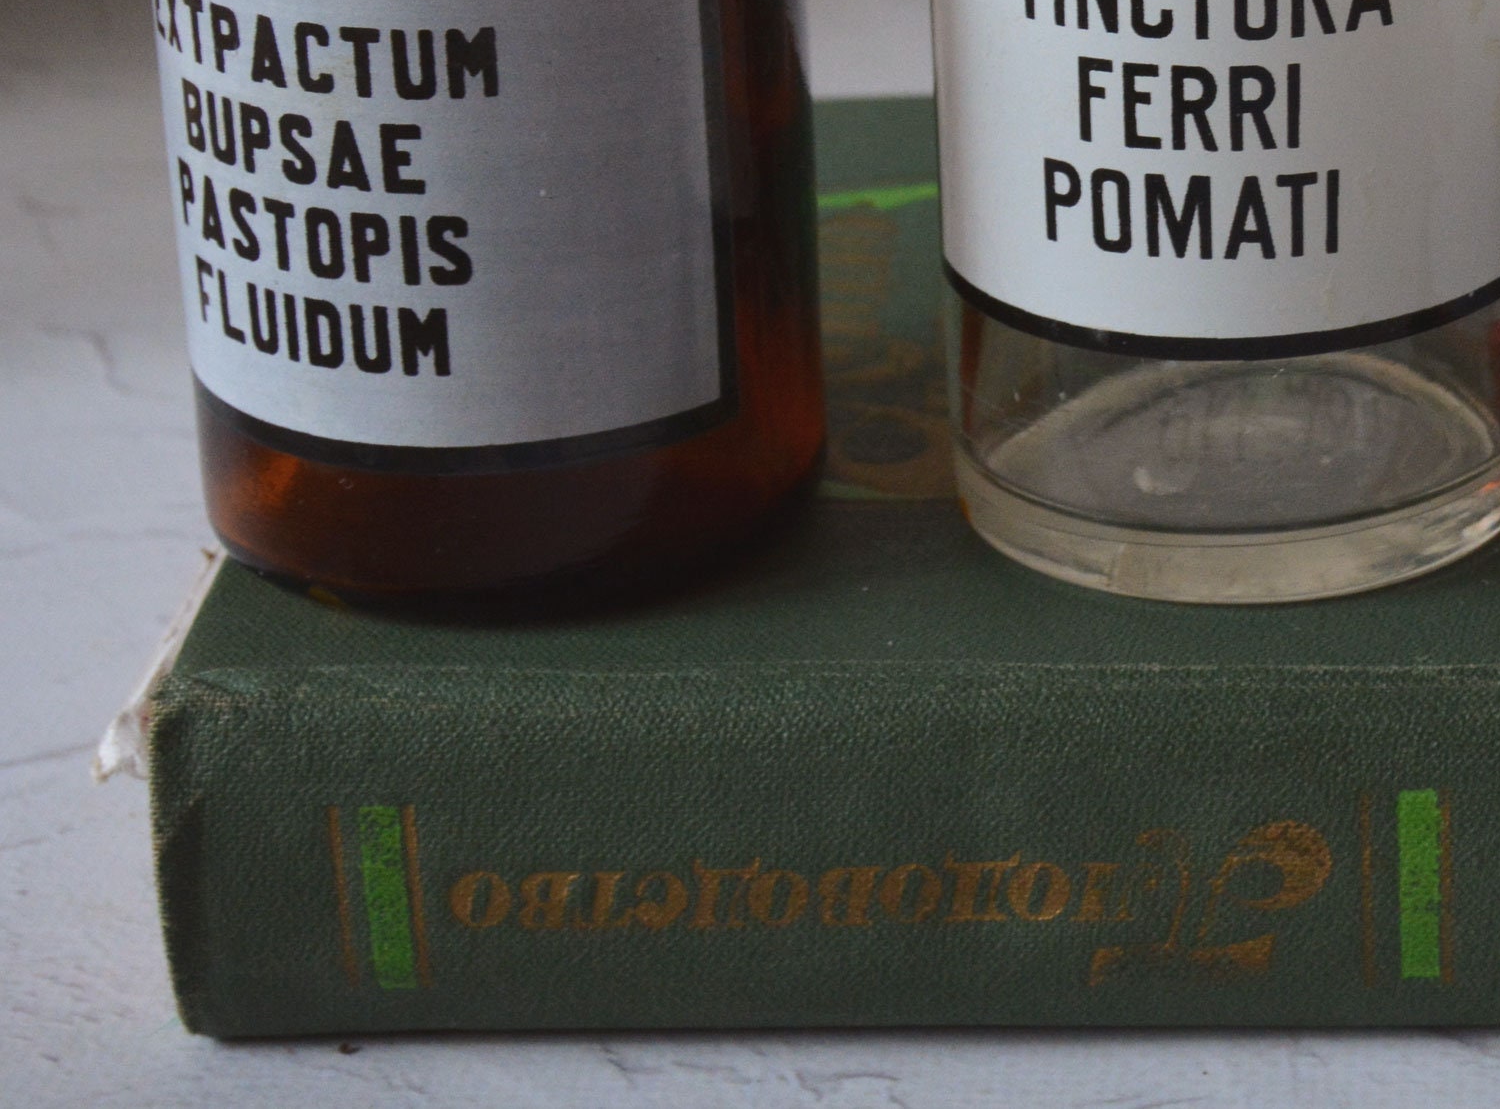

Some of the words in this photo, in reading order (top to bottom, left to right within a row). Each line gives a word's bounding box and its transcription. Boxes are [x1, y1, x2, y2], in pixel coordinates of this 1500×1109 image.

[182, 77, 427, 195] BUPSAE
[1077, 55, 1301, 152] FERRI
[177, 157, 474, 287] PASTOPIS
[1043, 156, 1341, 260] POMATI
[195, 255, 452, 377] FLUIDUM
